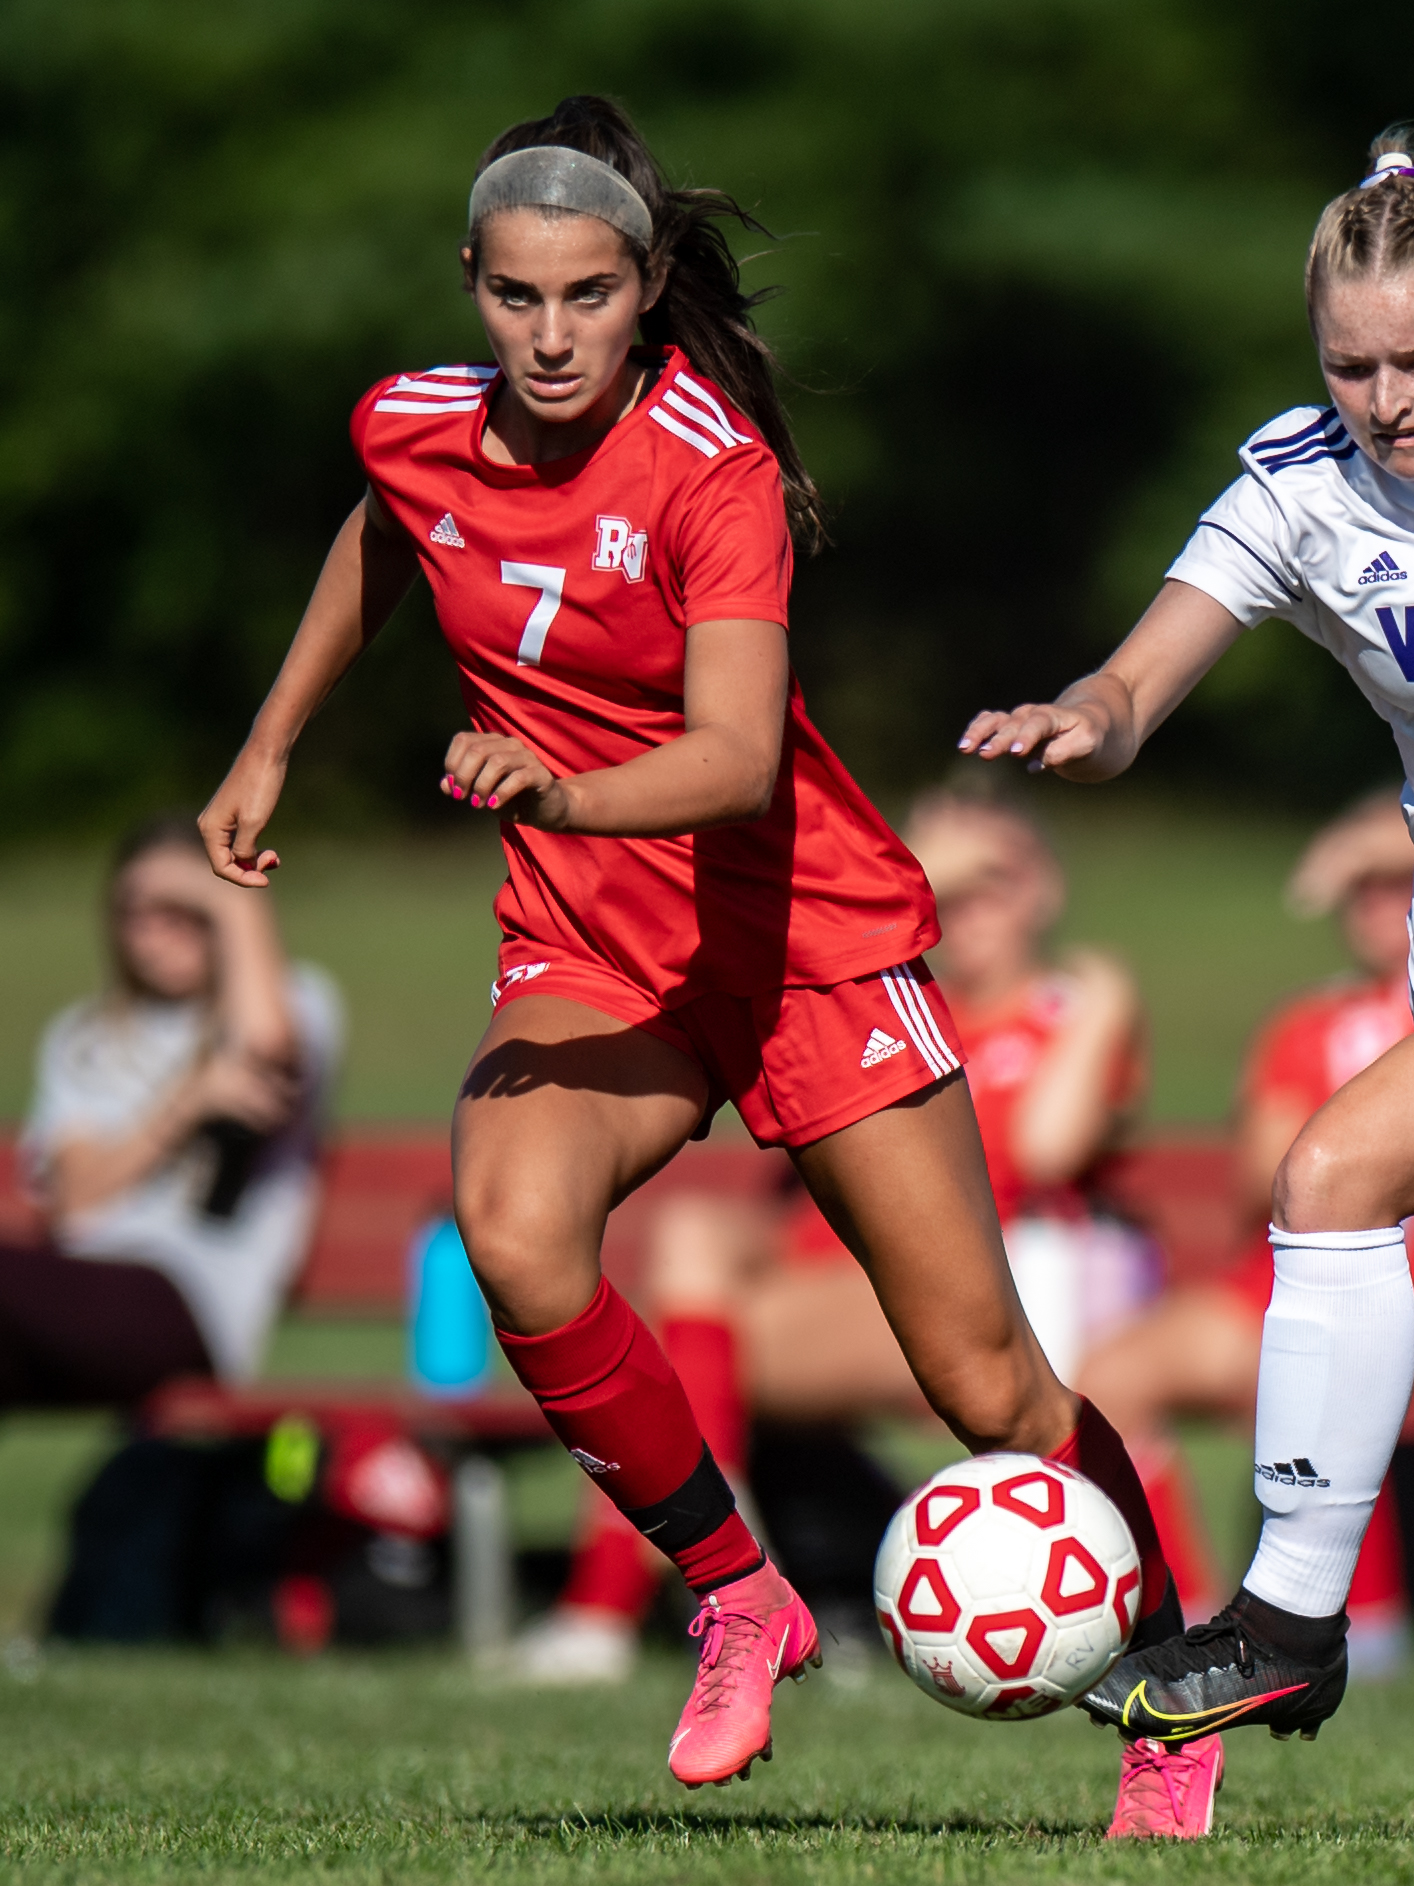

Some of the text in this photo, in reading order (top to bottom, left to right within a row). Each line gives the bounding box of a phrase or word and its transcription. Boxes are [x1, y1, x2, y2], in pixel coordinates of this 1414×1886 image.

[430, 531, 466, 549] adidas
[1357, 569, 1408, 585] adidas
[501, 560, 567, 667] 7
[860, 1039, 907, 1069] adidas
[1064, 1629, 1095, 1671] RV
